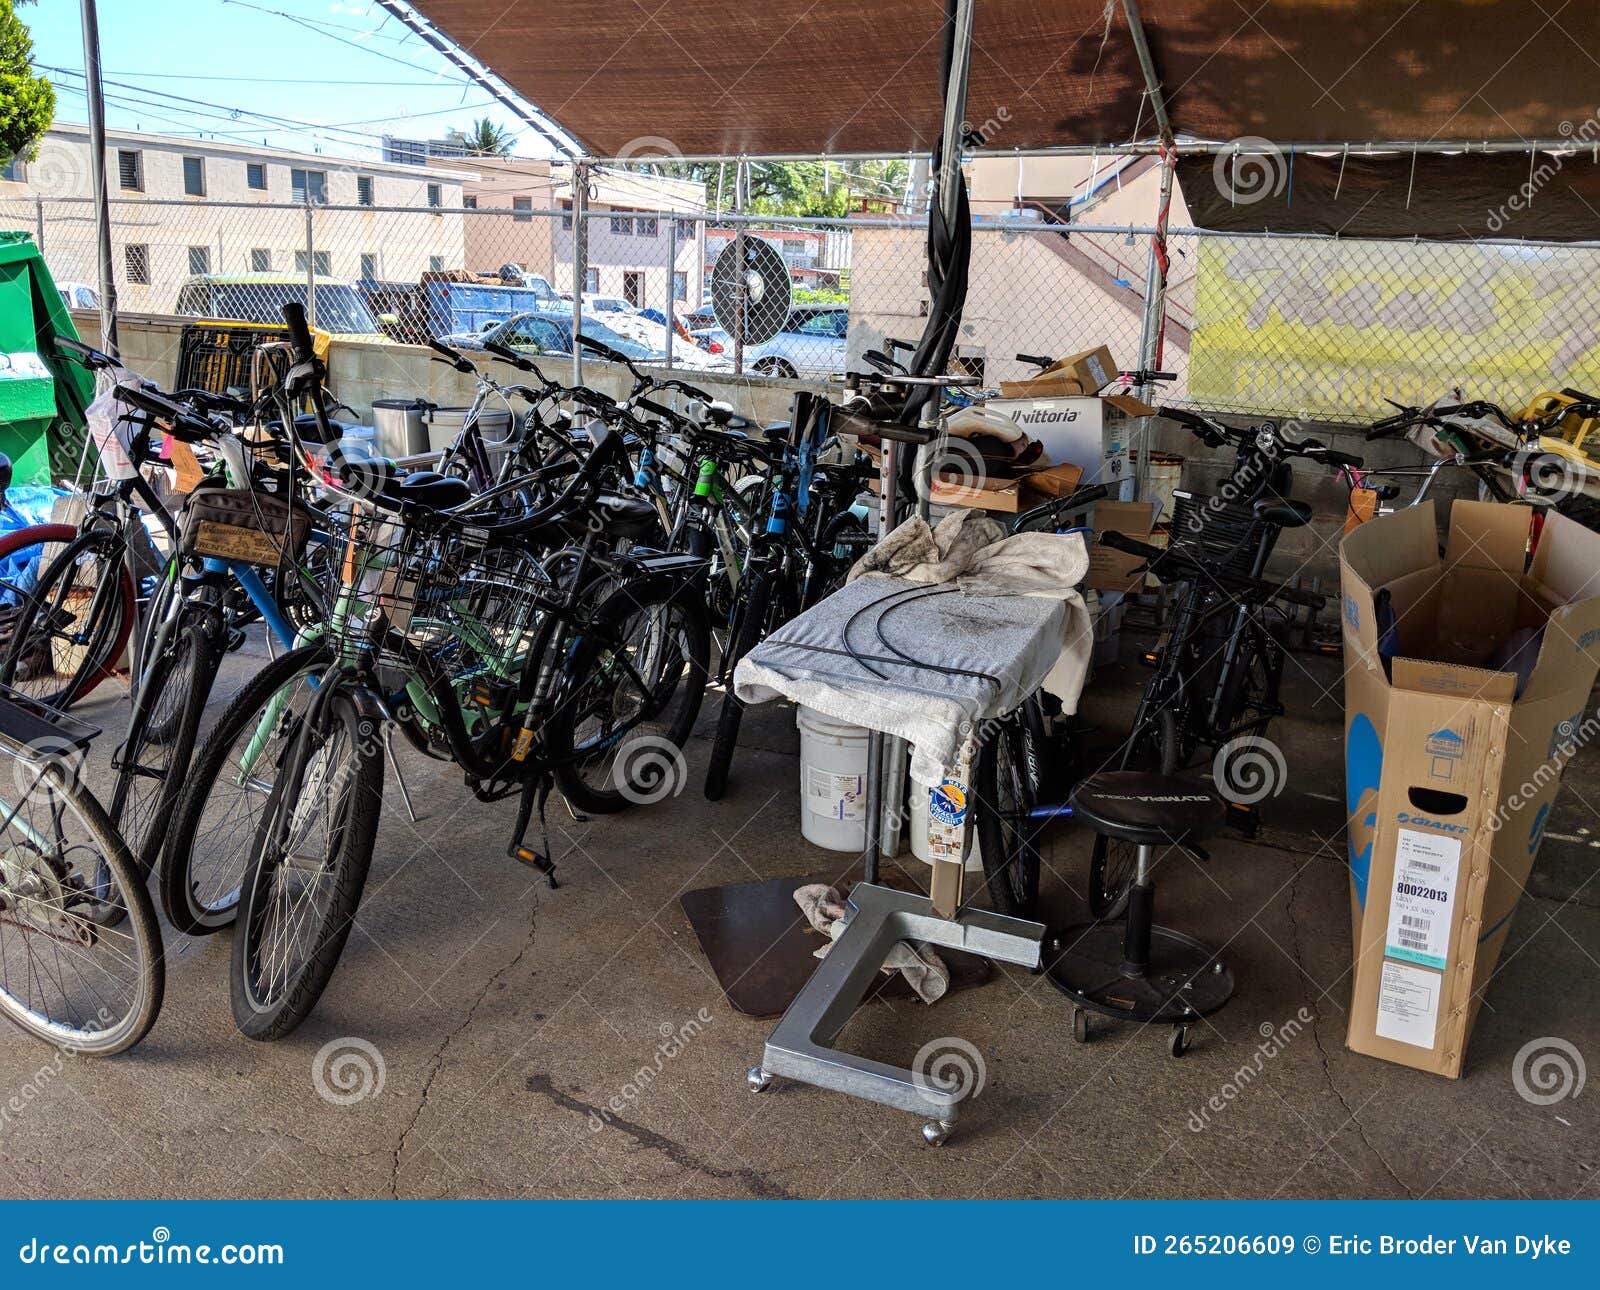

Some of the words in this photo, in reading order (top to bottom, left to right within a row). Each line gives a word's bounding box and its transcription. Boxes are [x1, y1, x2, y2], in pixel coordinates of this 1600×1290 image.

[948, 780, 967, 794] NATO
[1411, 814, 1469, 833] GIANT
[1397, 882, 1448, 903] 80022013
